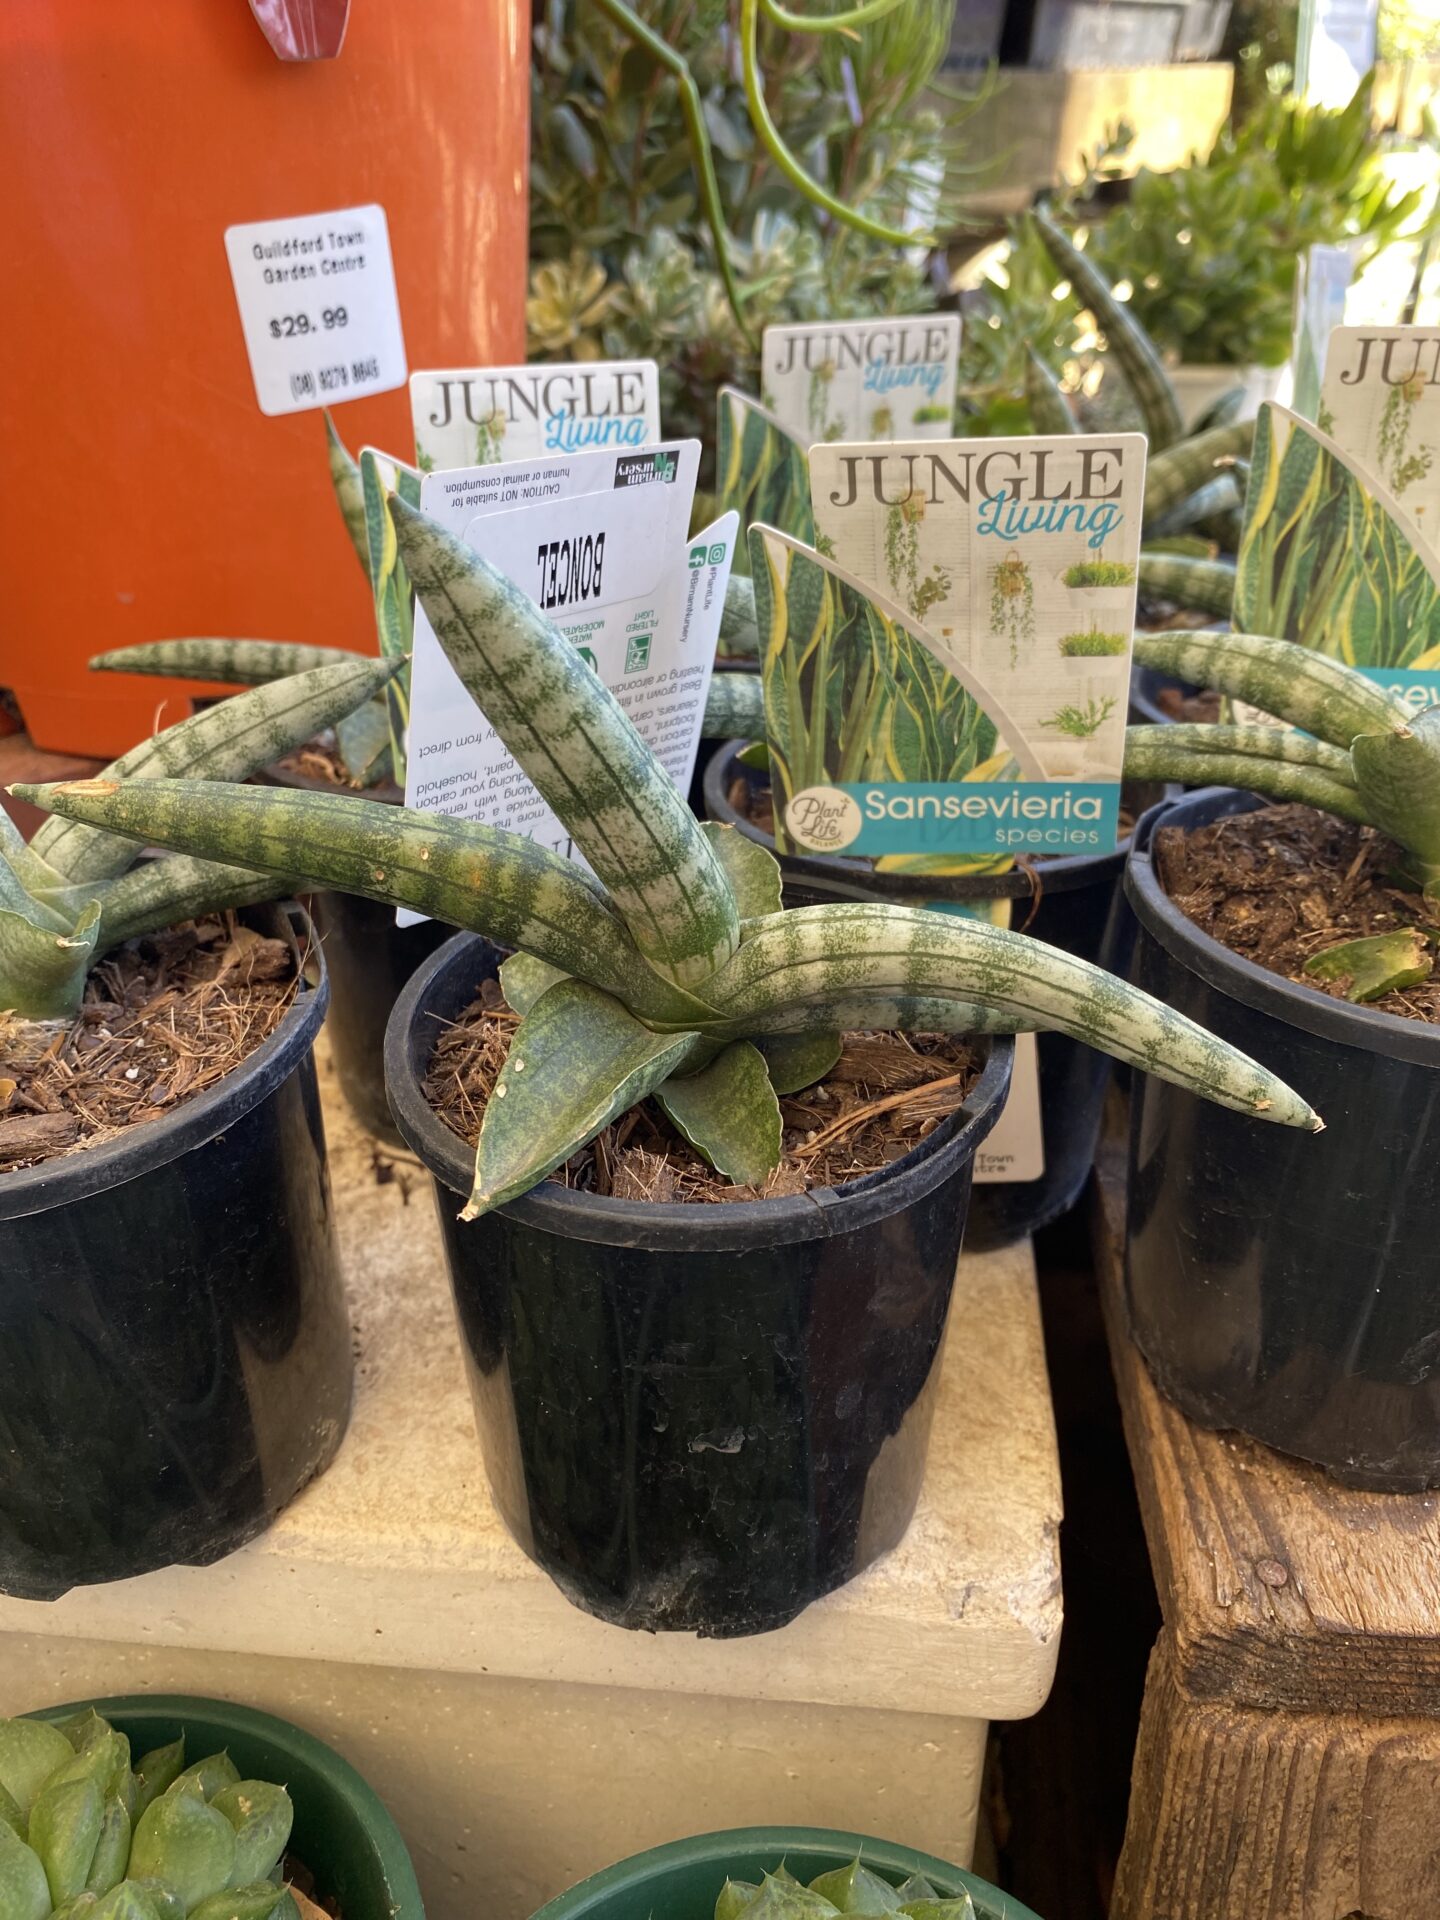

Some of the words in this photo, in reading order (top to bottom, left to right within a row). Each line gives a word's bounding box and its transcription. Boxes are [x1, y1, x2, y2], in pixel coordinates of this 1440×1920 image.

[253, 232, 324, 260] Guildford
[330, 230, 365, 250] Town
[263, 264, 317, 284] Garden
[321, 255, 366, 276] Centre
[776, 327, 949, 375] JUNGLE
[864, 356, 946, 397] Living
[430, 371, 645, 427] JUNGLE
[545, 408, 649, 452] Living
[503, 473, 530, 487] animal
[532, 471, 541, 481] or
[542, 467, 570, 480] human
[829, 448, 1123, 507] JUNGLE
[444, 479, 501, 493] consumption.
[520, 483, 560, 498] CAUTION:
[451, 498, 464, 508] for
[466, 491, 498, 505] suitable
[500, 490, 519, 502] NOT
[976, 489, 1125, 548] Living
[537, 531, 605, 610] BONCEL
[633, 609, 654, 621] LIGHT
[560, 620, 605, 635] MODERATEL
[626, 619, 659, 632] FILTERED
[656, 674, 667, 683] or
[669, 665, 705, 680] heating
[647, 683, 677, 700] grown
[680, 679, 702, 692] Best
[634, 694, 644, 704] in
[456, 733, 482, 747] from
[419, 741, 452, 758] direct
[484, 760, 514, 776] paint,
[416, 770, 477, 797] household
[460, 780, 485, 797] your
[489, 773, 526, 789] ducing
[416, 791, 457, 809] carbon
[475, 794, 497, 807] with
[865, 789, 1103, 820] Sansevieria
[492, 807, 500, 816] a
[517, 809, 545, 823] more
[791, 797, 848, 825] Plant
[801, 815, 841, 840] Life
[994, 826, 1099, 846] species
[978, 1153, 1014, 1163] Town
